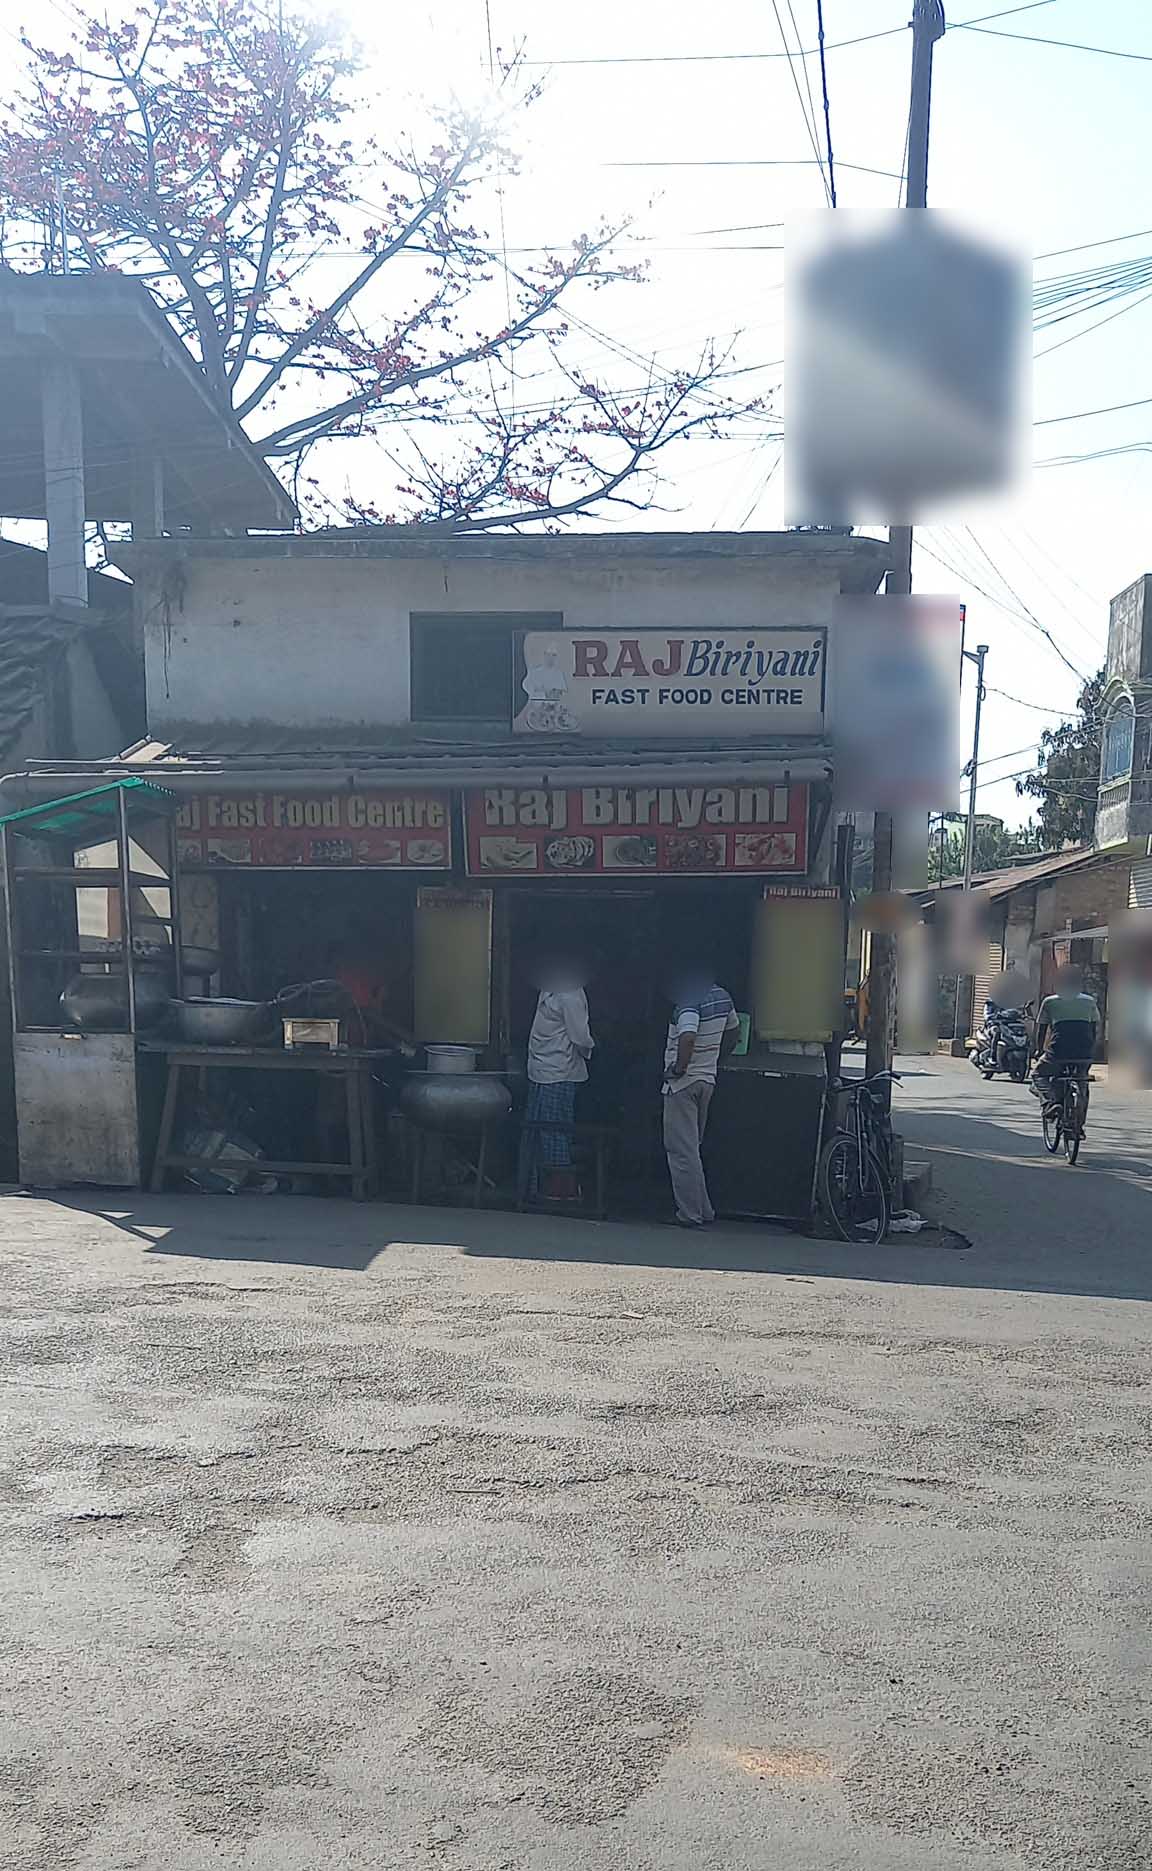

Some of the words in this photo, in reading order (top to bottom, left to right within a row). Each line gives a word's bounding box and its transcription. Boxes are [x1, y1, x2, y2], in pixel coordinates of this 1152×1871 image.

[571, 639, 685, 678] RAJ
[683, 639, 823, 687] Biriyani
[591, 688, 651, 706] FAST
[658, 688, 713, 706] FOOD
[720, 688, 804, 706] CENTRE
[176, 795, 201, 831] aj
[207, 793, 267, 828] Fast
[272, 793, 336, 828] Food
[348, 796, 445, 829] Centre
[484, 788, 568, 830] Raj
[581, 784, 789, 829] Biriyani
